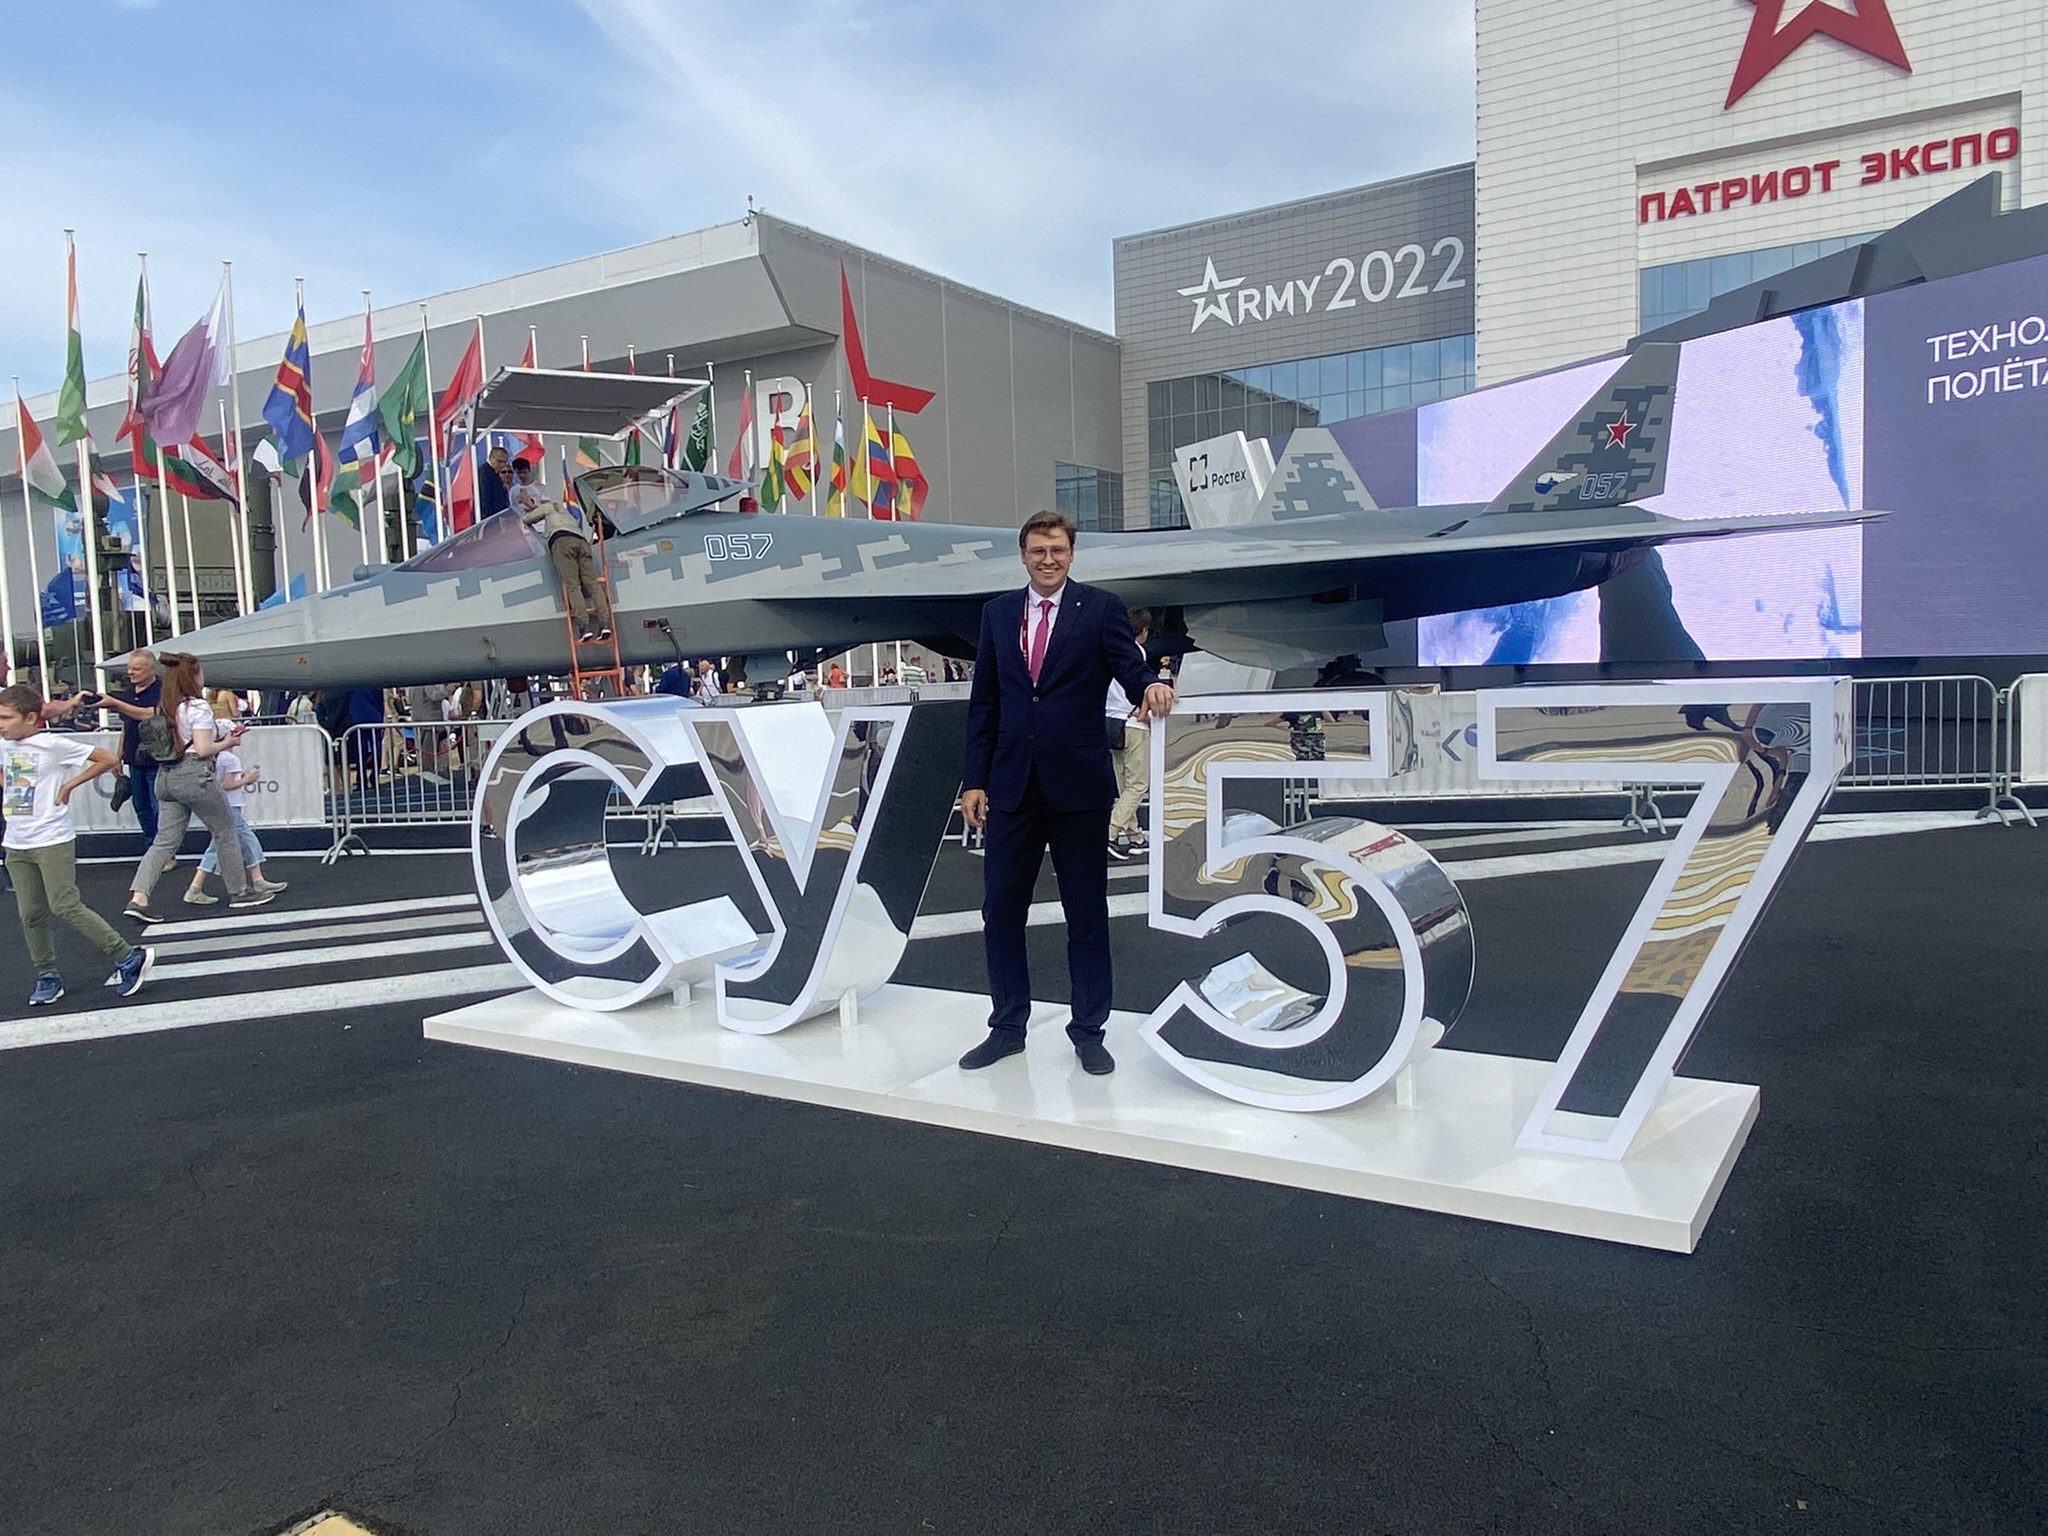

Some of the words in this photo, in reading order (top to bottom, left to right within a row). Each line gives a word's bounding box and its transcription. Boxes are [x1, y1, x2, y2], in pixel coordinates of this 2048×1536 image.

[1640, 159, 1841, 224] ПАТРИОТ
[1860, 126, 2020, 186] ЭКСПО
[1926, 316, 2048, 363] ТЕХНО
[1211, 469, 1247, 488] Ростех
[1578, 471, 1629, 500] 057
[703, 533, 774, 561] 057
